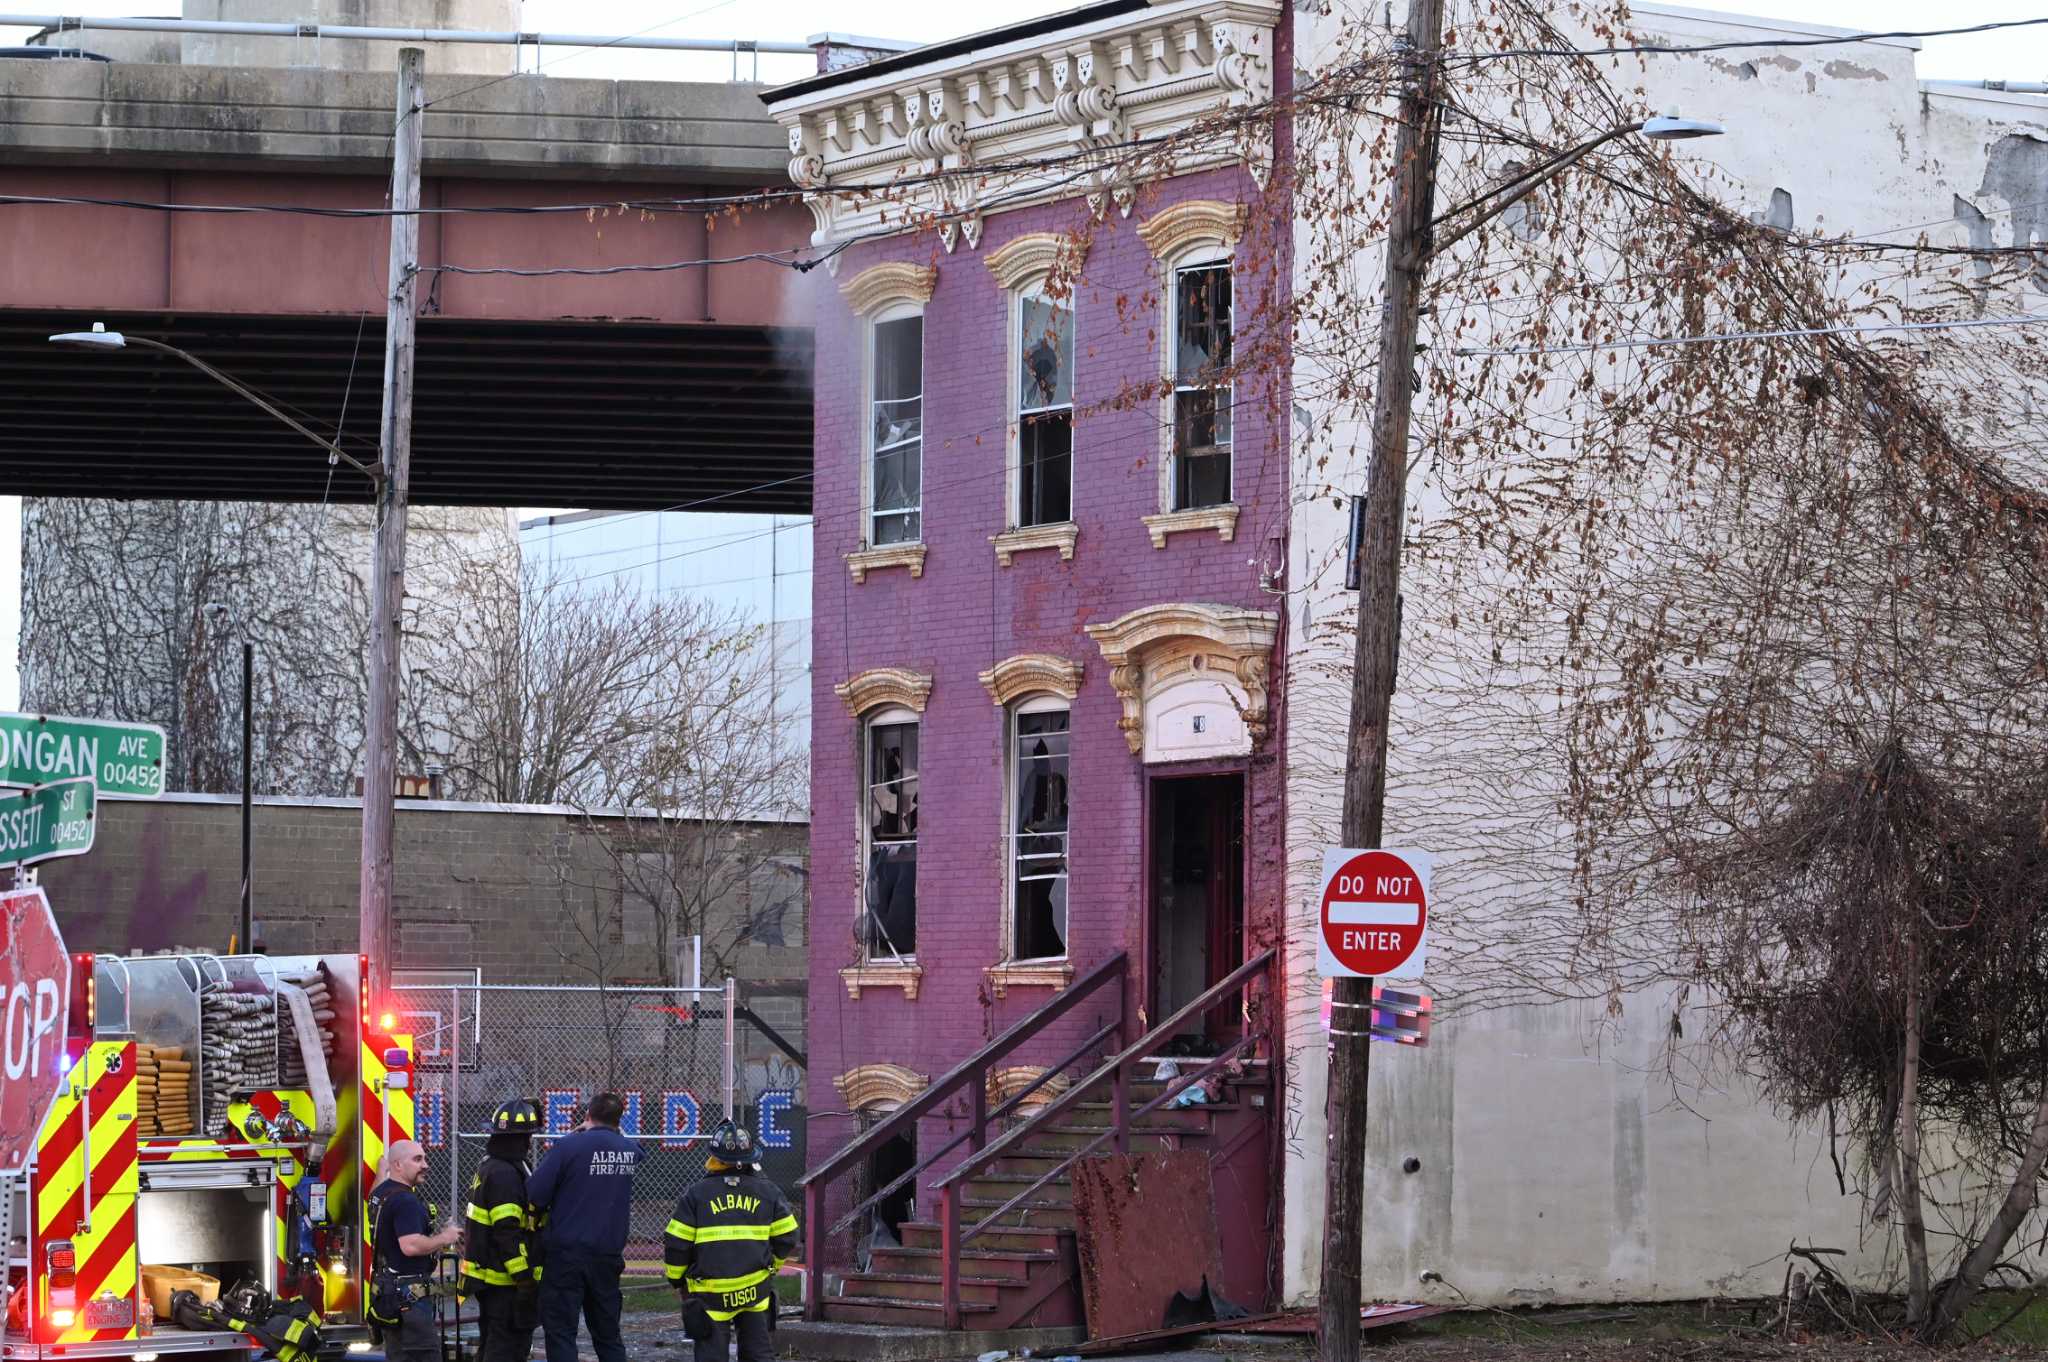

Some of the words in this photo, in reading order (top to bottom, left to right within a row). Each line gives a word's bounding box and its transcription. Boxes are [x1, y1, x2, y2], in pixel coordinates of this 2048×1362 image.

[118, 736, 148, 758] AVE
[104, 762, 160, 788] 00452
[63, 789, 77, 811] ST
[50, 821, 86, 844] 00452
[1339, 875, 1364, 895] DO
[1376, 876, 1412, 896] NOT
[1343, 930, 1401, 951] ENTER
[0, 978, 59, 1080] OP
[591, 1151, 635, 1164] ALBANY
[710, 1194, 761, 1215] ALBANY
[722, 1286, 757, 1308] FUSCO
